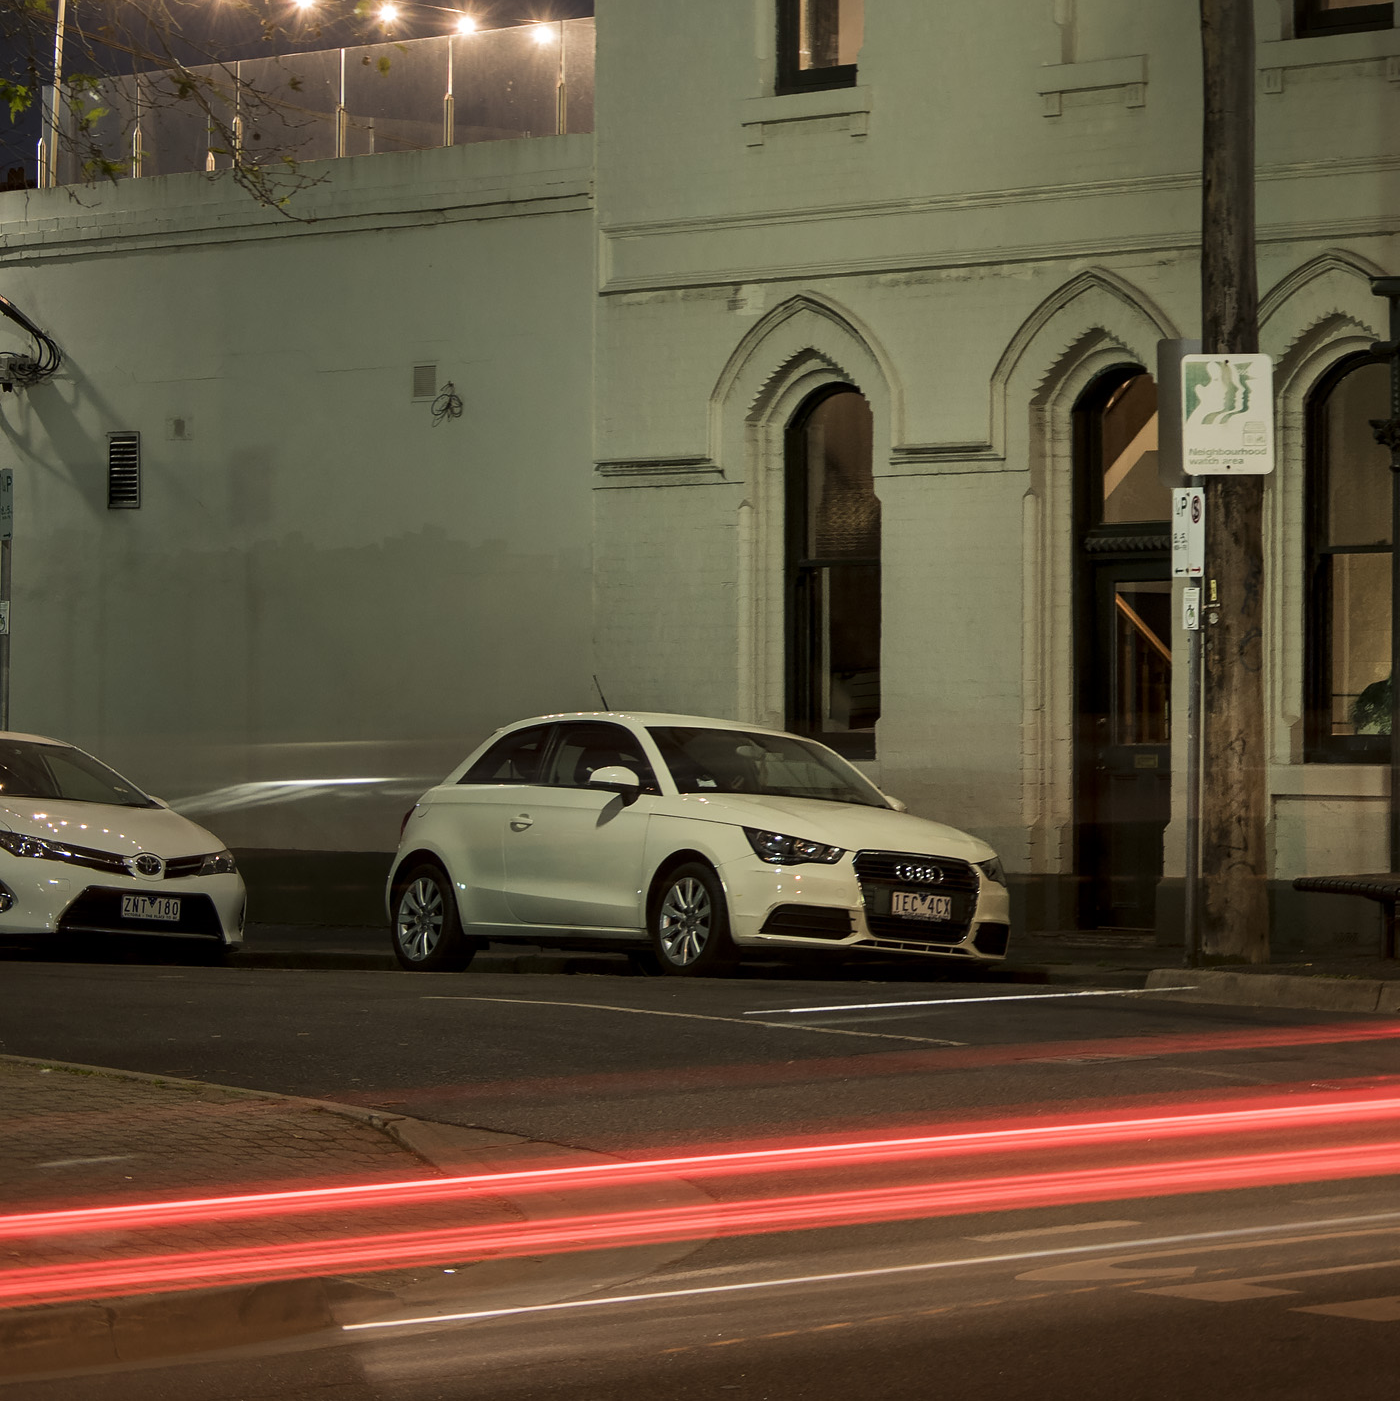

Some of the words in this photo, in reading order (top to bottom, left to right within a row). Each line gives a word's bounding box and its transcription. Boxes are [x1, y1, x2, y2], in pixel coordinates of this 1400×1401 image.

[1188, 448, 1267, 458] Neighbourhood
[124, 897, 147, 914] ZNT
[158, 899, 179, 916] 180
[895, 894, 918, 912] 1EC
[927, 897, 951, 915] 4CX
